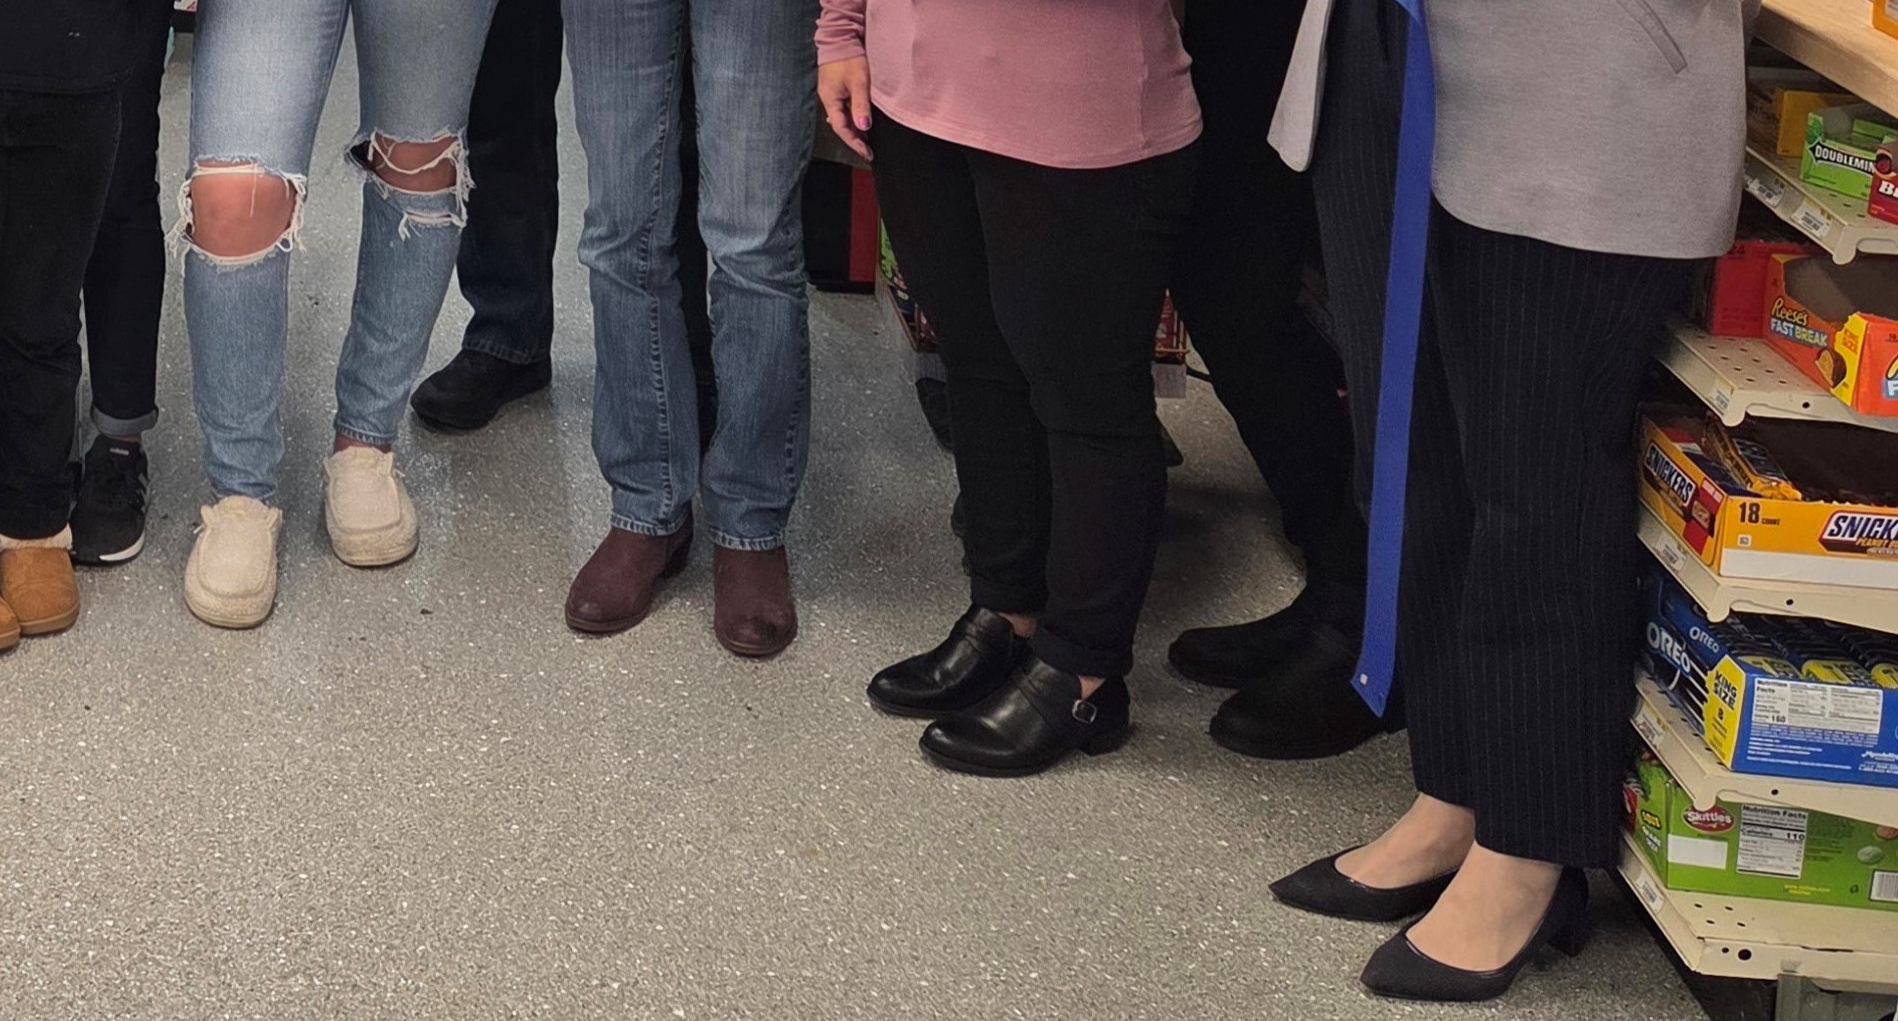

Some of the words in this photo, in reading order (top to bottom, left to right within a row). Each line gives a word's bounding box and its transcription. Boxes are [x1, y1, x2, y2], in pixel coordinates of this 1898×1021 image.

[1814, 142, 1876, 174] DOUBLEMIN
[1771, 297, 1808, 327] Reese's
[1770, 317, 1794, 336] FAST
[1794, 324, 1828, 348] BREAK
[1646, 445, 1694, 503] SNICKERS
[1738, 501, 1761, 525] 18
[1828, 514, 1898, 540] SNICK
[1646, 621, 1692, 675] OREO
[1689, 625, 1720, 654] OREO
[1712, 681, 1736, 712] SIZE
[1714, 669, 1738, 699] KING
[1686, 810, 1733, 824] Skittles
[1785, 832, 1805, 841] 110
